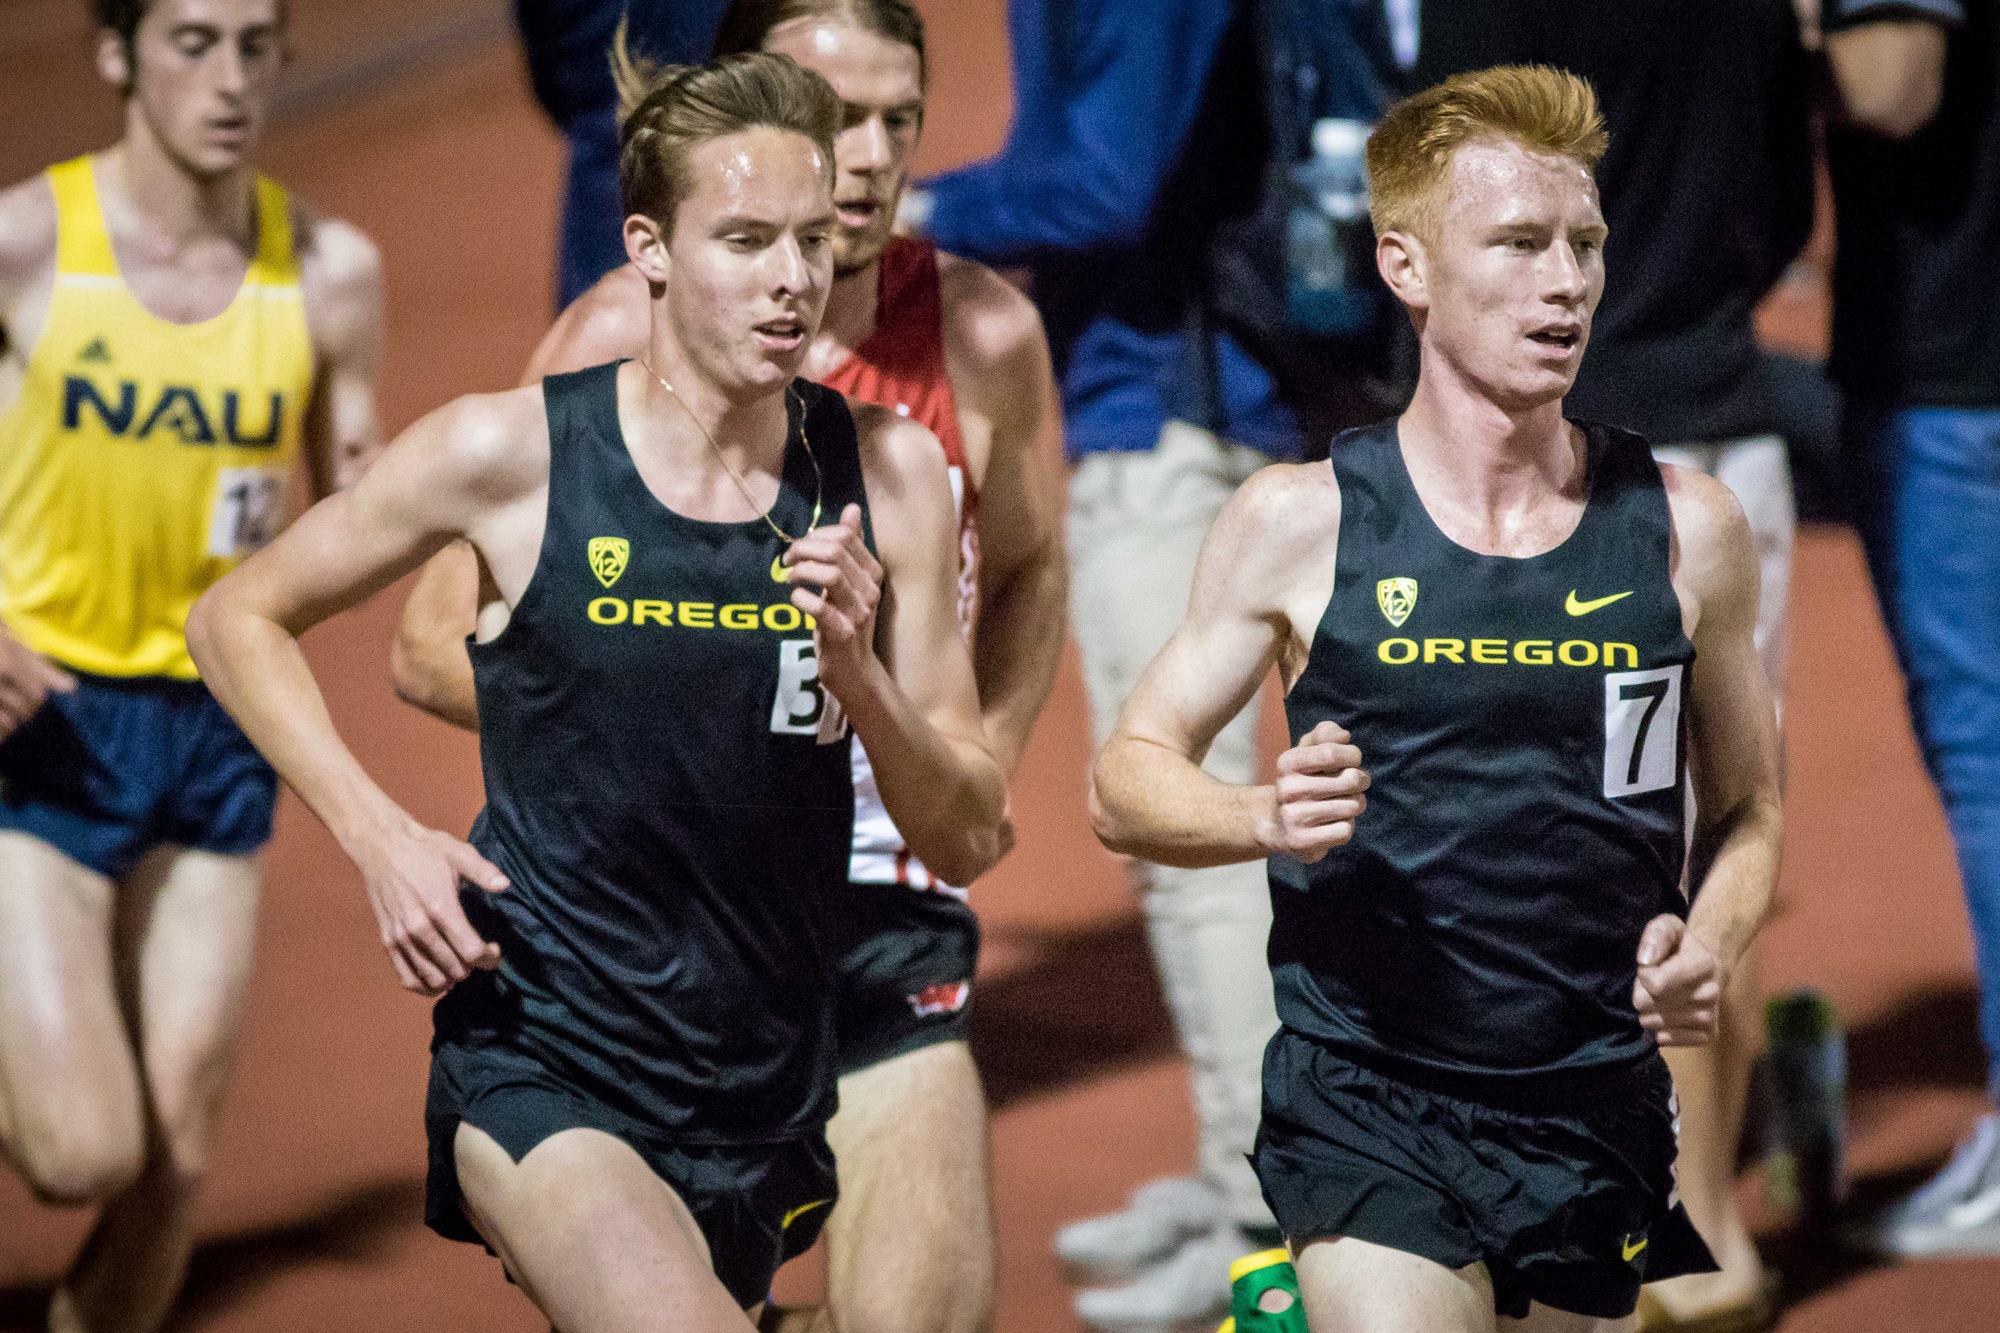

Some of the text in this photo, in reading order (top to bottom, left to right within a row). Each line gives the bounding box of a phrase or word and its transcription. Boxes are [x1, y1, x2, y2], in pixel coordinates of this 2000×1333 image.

[62, 374, 283, 447] NAU
[599, 557, 618, 576] 12
[1388, 599, 1407, 617] 12
[1377, 638, 1639, 668] OREGON
[1618, 678, 1670, 785] 7
